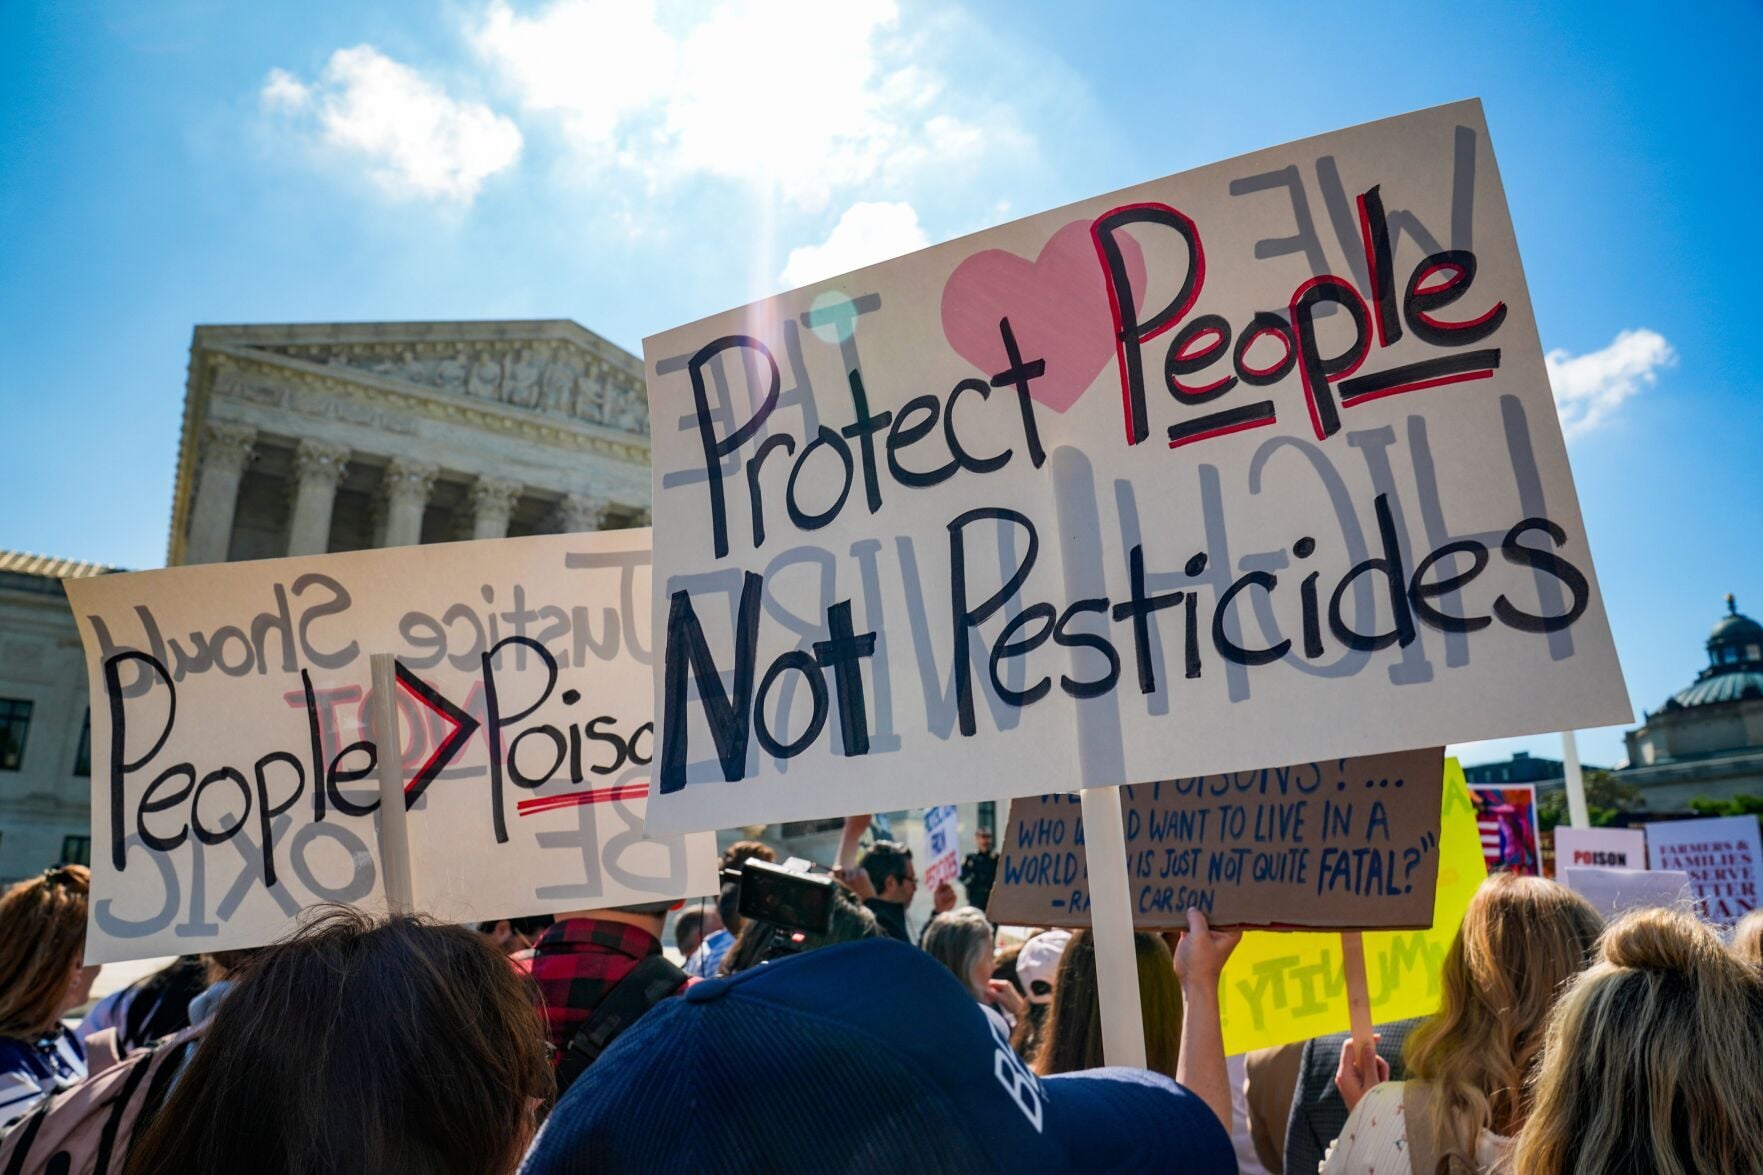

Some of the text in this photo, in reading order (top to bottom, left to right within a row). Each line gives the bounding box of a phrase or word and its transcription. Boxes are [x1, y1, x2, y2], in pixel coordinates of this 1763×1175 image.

[688, 184, 1507, 559] Protect People
[660, 493, 1590, 794] Not Pesticides
[105, 651, 382, 887] People
[1018, 818, 1066, 849] WHO
[1150, 808, 1210, 843] WANT
[1219, 804, 1246, 843] TO
[1254, 800, 1308, 843] LIVE
[1322, 800, 1352, 843] IN
[1365, 800, 1390, 843] A
[1004, 852, 1079, 886] WORLD
[1136, 850, 1155, 879] IS
[1160, 848, 1202, 879] JUST
[1252, 848, 1309, 884] QUITE
[1573, 850, 1627, 867] POISON
[1661, 854, 1753, 869] FAMILIES
[1689, 867, 1756, 881] SERVE
[1138, 885, 1216, 914] CARSON
